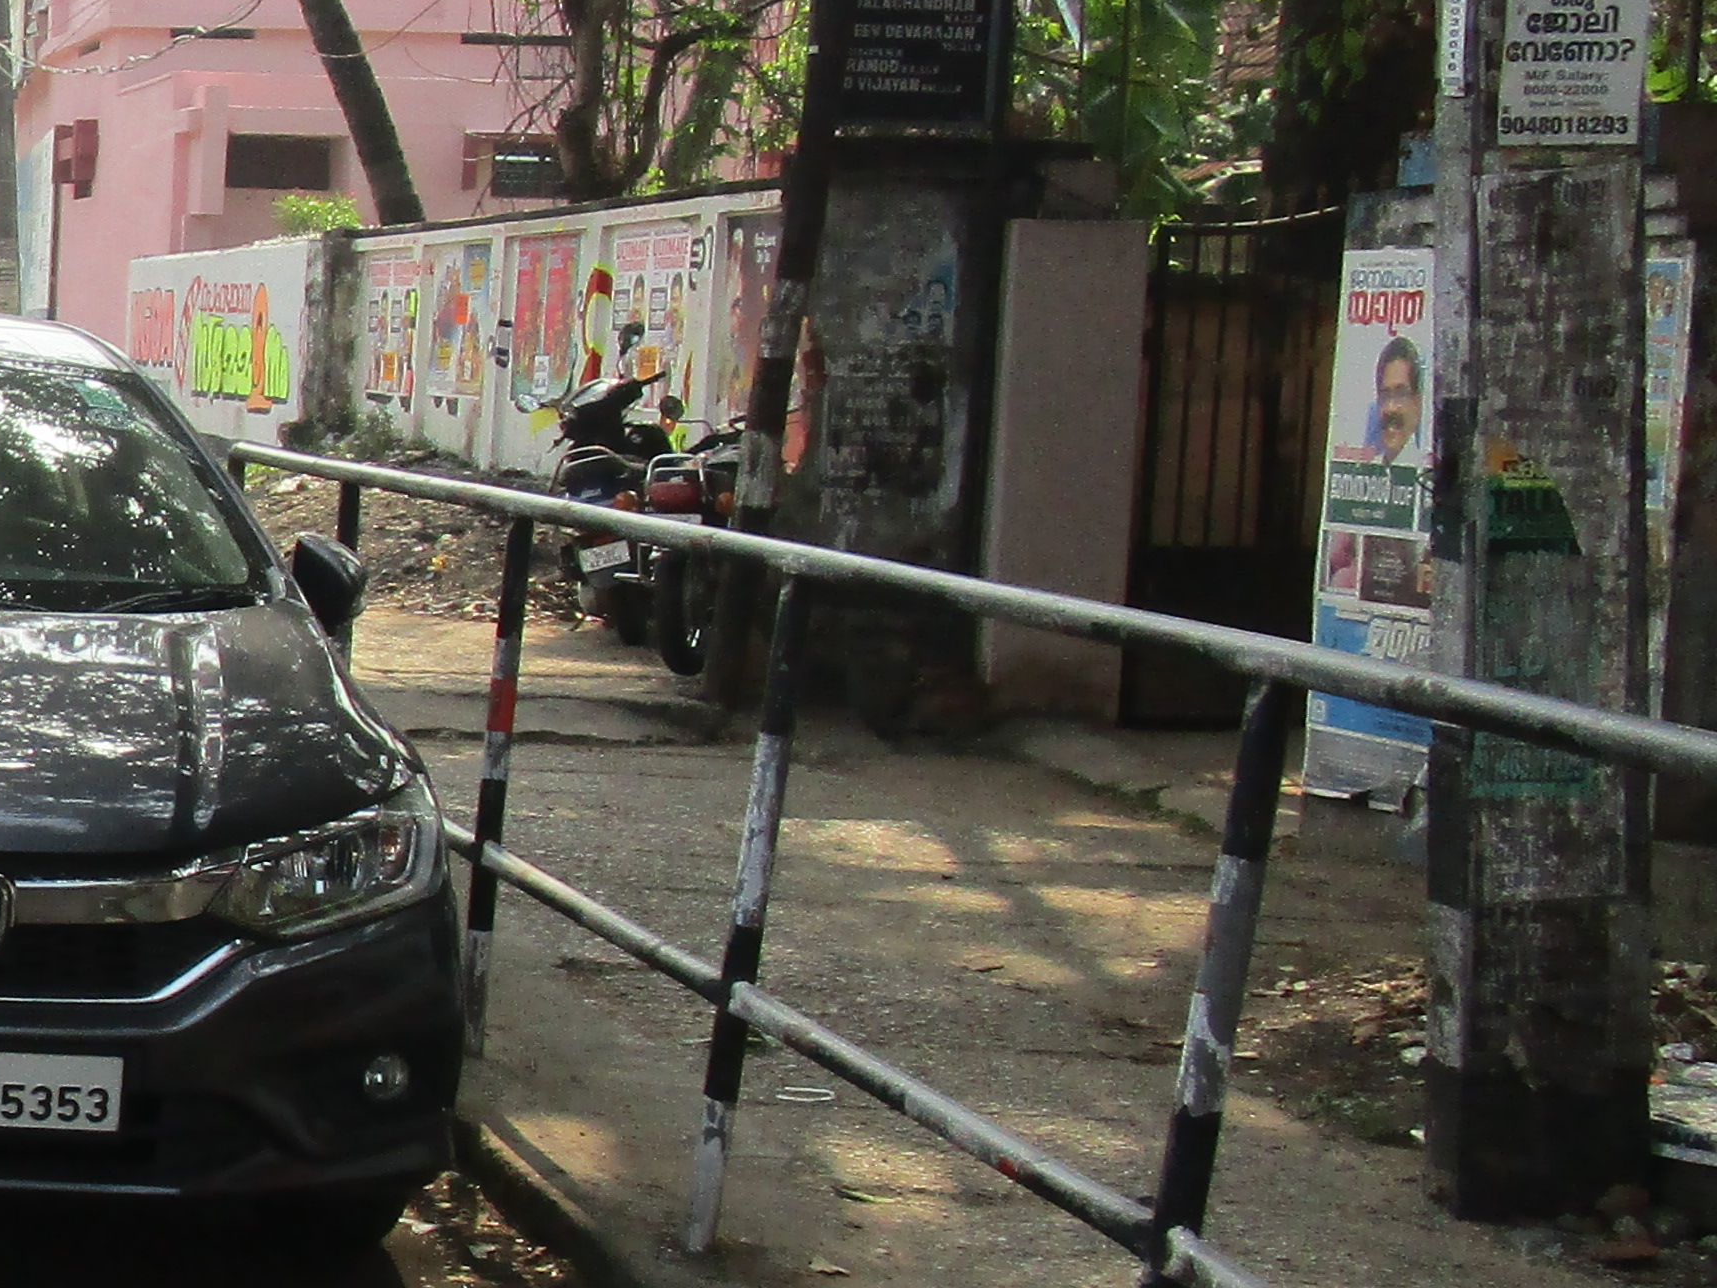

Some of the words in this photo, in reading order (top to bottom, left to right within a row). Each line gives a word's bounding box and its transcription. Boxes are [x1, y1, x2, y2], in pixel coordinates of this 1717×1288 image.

[1526, 5, 1619, 34] ജോലി
[1500, 115, 1629, 135] 9048018293
[1, 1084, 109, 1123] 5353
